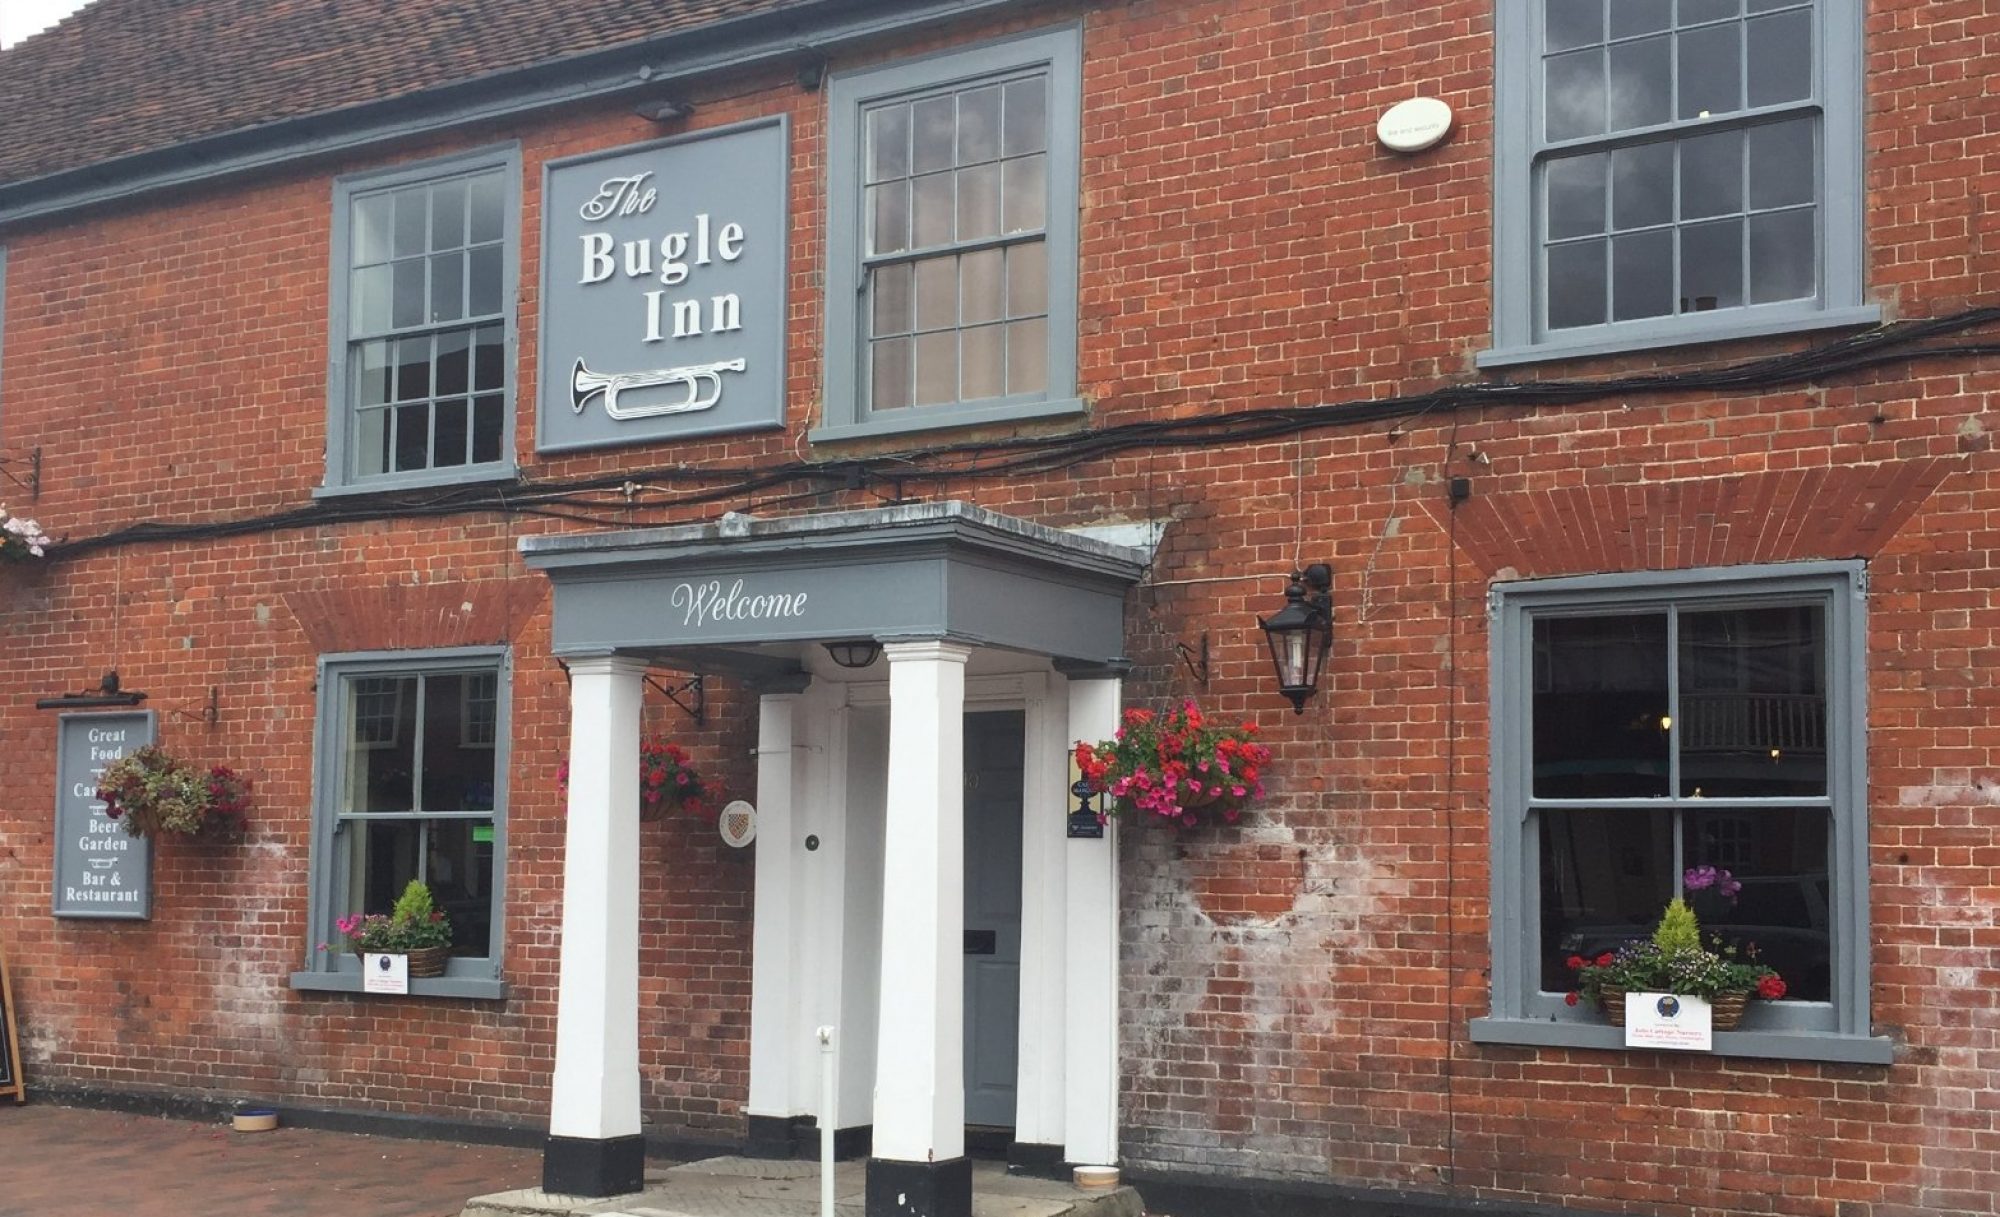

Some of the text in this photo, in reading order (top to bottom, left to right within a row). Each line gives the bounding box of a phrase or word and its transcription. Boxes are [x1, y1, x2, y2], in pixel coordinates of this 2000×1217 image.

[580, 170, 657, 221] The
[578, 213, 745, 285] Bugle
[642, 290, 743, 342] Inn
[671, 578, 808, 627] Welcome
[88, 727, 126, 743] Great
[91, 747, 122, 760] Food
[89, 819, 119, 833] Beer
[78, 837, 128, 851] Garden
[82, 871, 121, 886] Bar &
[66, 887, 139, 902] Restaurant
